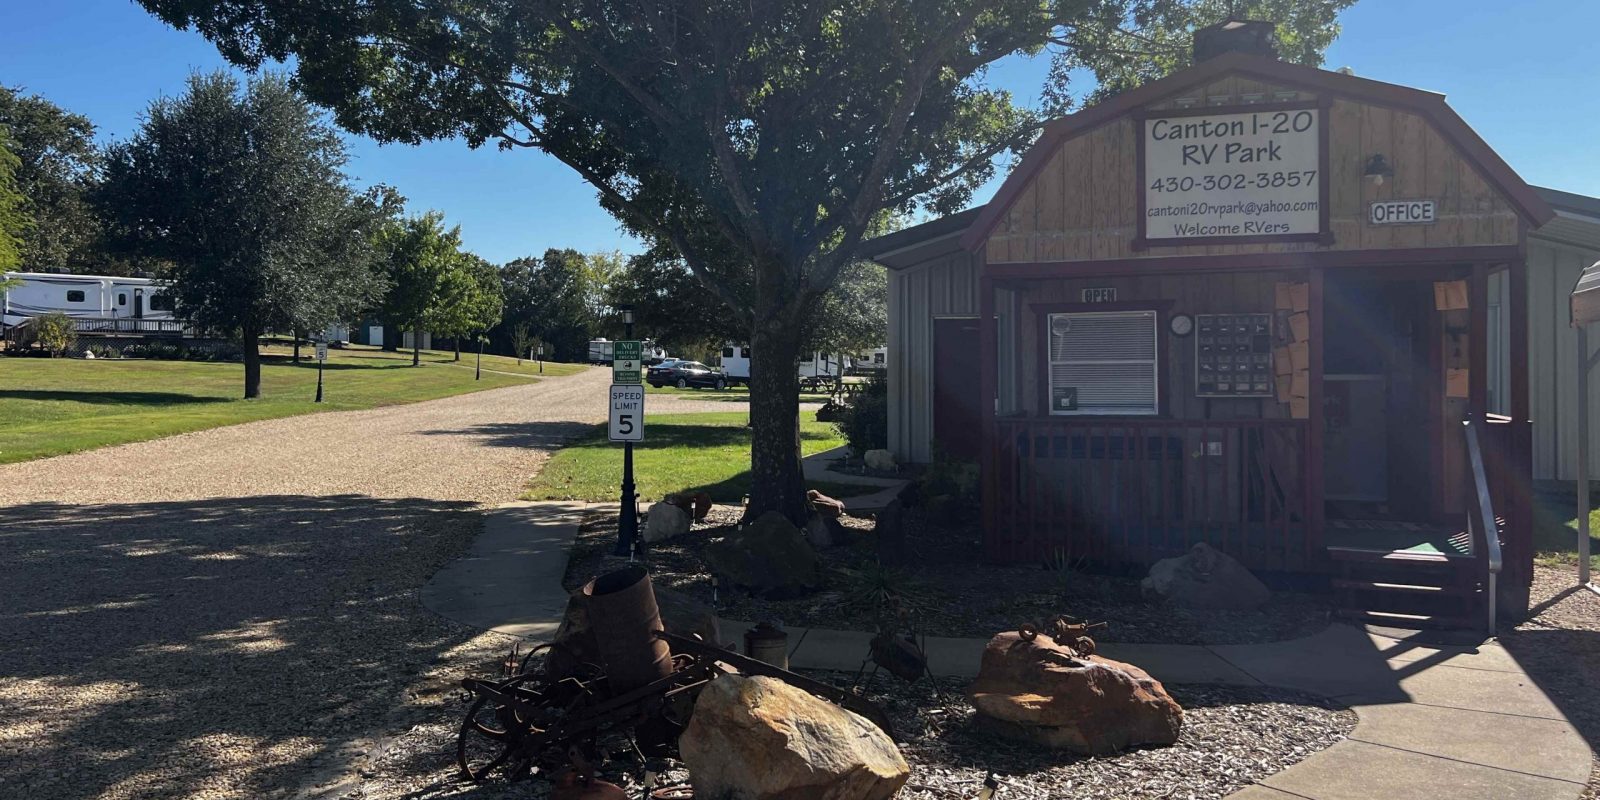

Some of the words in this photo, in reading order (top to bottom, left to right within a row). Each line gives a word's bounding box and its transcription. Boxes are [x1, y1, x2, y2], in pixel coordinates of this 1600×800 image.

[1151, 118, 1244, 141] Canton
[1252, 111, 1313, 136] I-20
[1182, 143, 1218, 166] RV
[1225, 140, 1282, 164] Park
[1150, 170, 1318, 193] 430-302-3857
[1147, 200, 1318, 219] cantoni20rvpark@yahoo.com
[1373, 202, 1433, 221] OFFICE
[1174, 221, 1240, 236] Welcome
[1244, 220, 1290, 234] RVers
[1085, 289, 1115, 303] OPEN
[619, 415, 633, 434] 5
